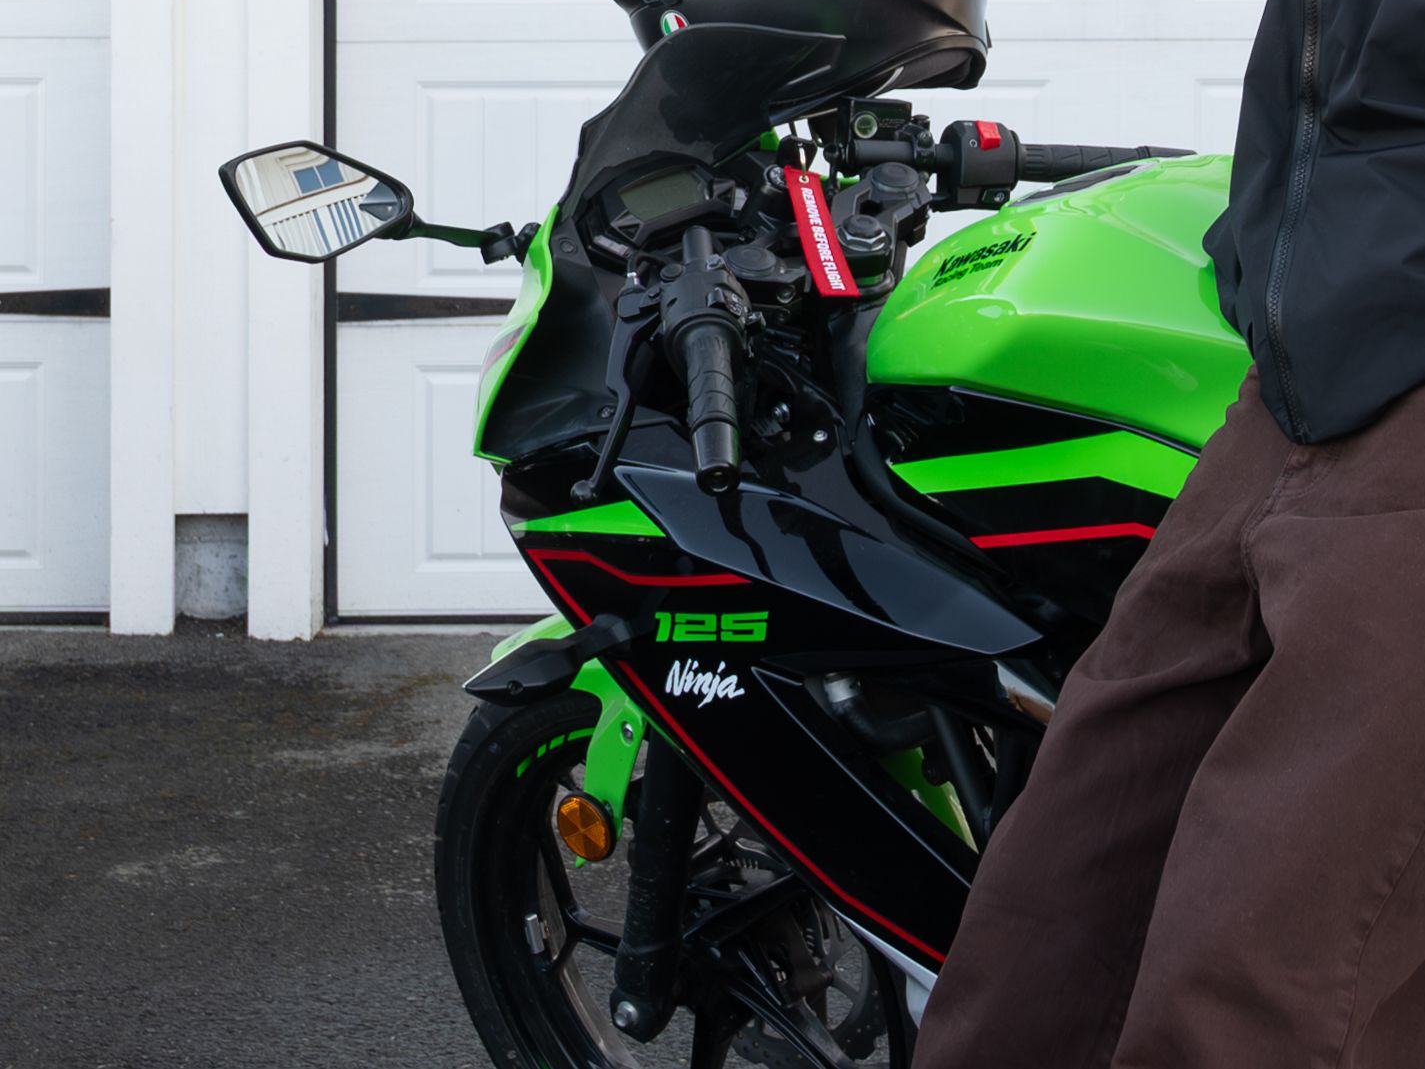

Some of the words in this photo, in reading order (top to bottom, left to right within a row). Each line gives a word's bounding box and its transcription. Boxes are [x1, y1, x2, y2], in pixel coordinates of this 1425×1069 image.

[801, 187, 823, 226] REMOVE
[811, 225, 834, 262] BEFORE
[932, 231, 1037, 281] Kawasaki
[822, 261, 846, 291] FLIGHT
[969, 258, 1004, 274] Team
[655, 611, 769, 642] 125
[665, 658, 745, 708] Ninja
